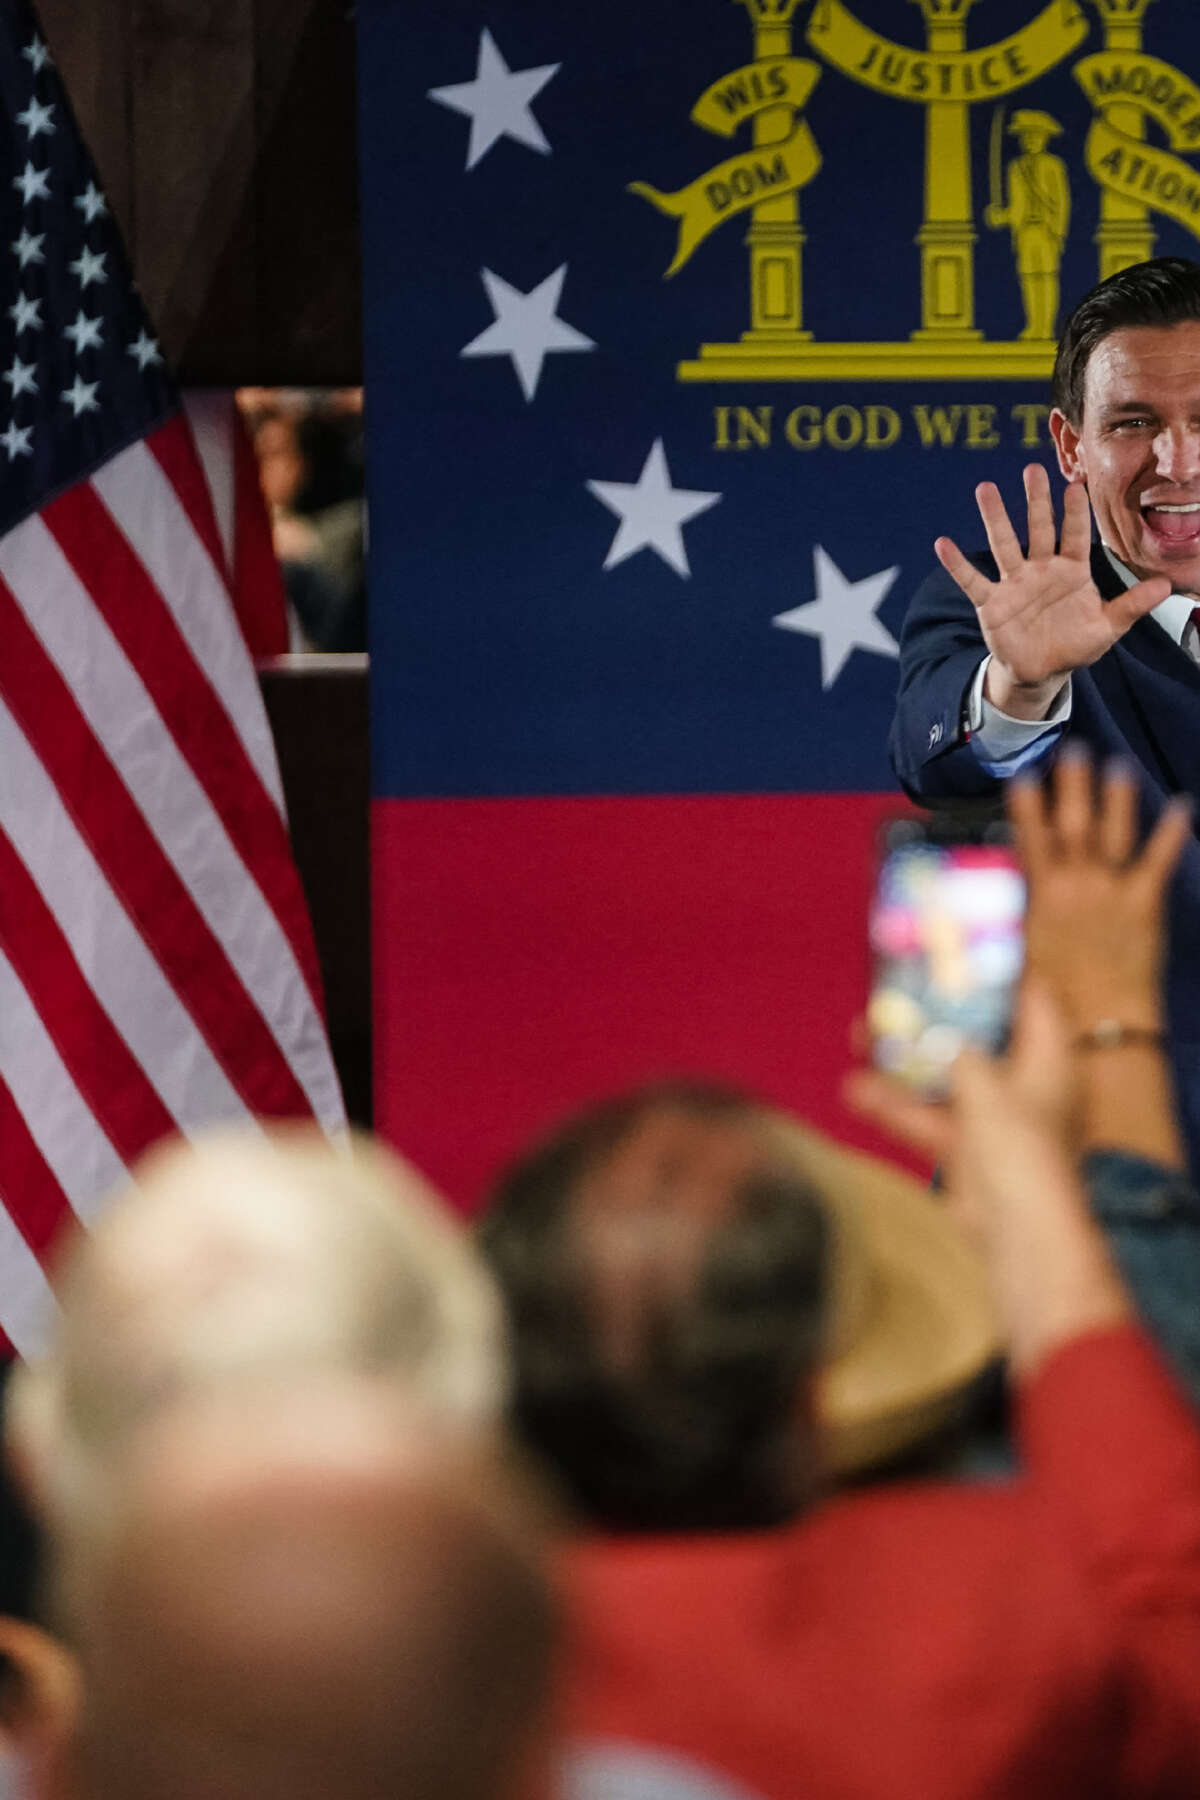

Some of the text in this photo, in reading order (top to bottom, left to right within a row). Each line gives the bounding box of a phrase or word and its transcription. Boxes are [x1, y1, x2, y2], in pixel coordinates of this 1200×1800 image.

[712, 65, 789, 115] WIS
[860, 44, 1028, 95] JUSTICE
[705, 152, 791, 213] DOM
[713, 404, 773, 447] IN
[785, 403, 901, 449] GOD
[912, 403, 1000, 446] WE
